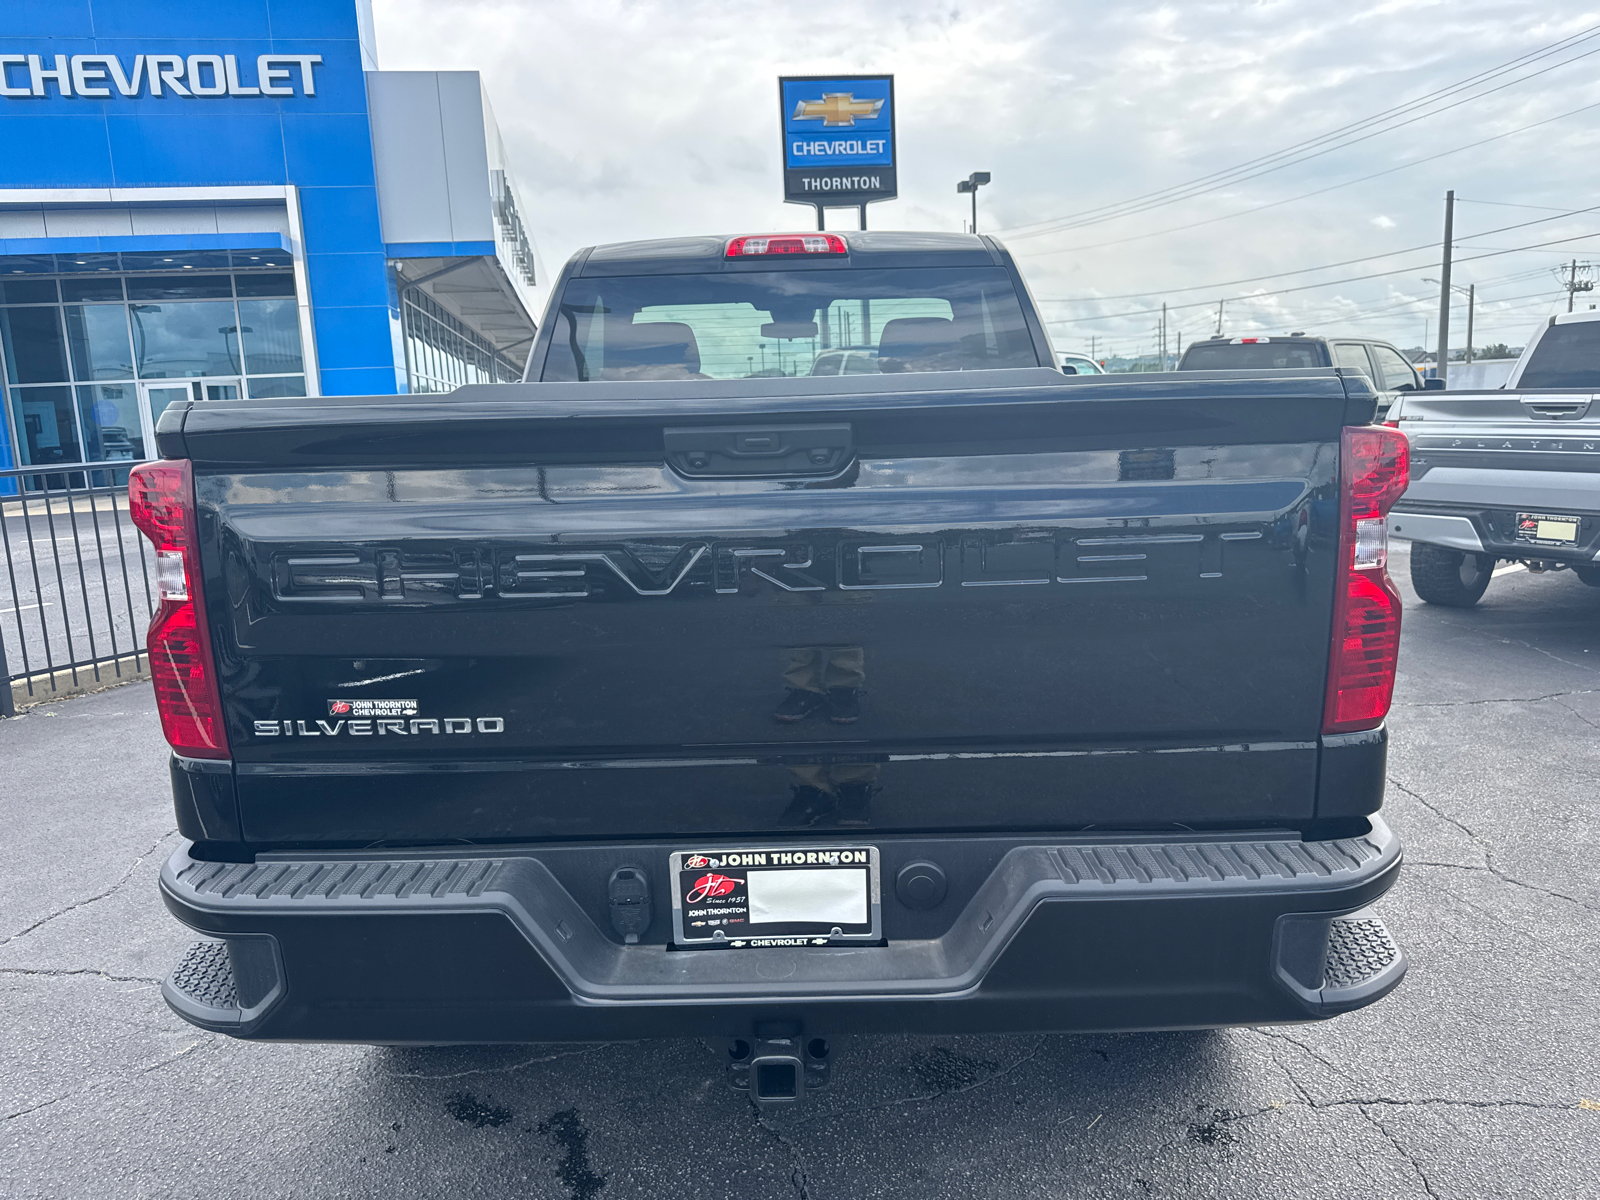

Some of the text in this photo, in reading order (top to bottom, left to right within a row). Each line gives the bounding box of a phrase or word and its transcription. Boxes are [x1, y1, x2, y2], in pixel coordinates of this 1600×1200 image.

[0, 54, 323, 97] CHEVROLET
[792, 139, 886, 156] CHEVROLET
[802, 176, 880, 191] THORNTON
[270, 528, 1264, 603] CHEVROLET
[352, 700, 417, 709] JOHN THORNTON
[353, 708, 402, 716] CHEVROLET
[253, 717, 505, 736] SILVERADO
[719, 851, 867, 866] JOHN THORNTON
[688, 907, 747, 917] JOHN THORNTON
[750, 938, 808, 947] CHEVROLET
